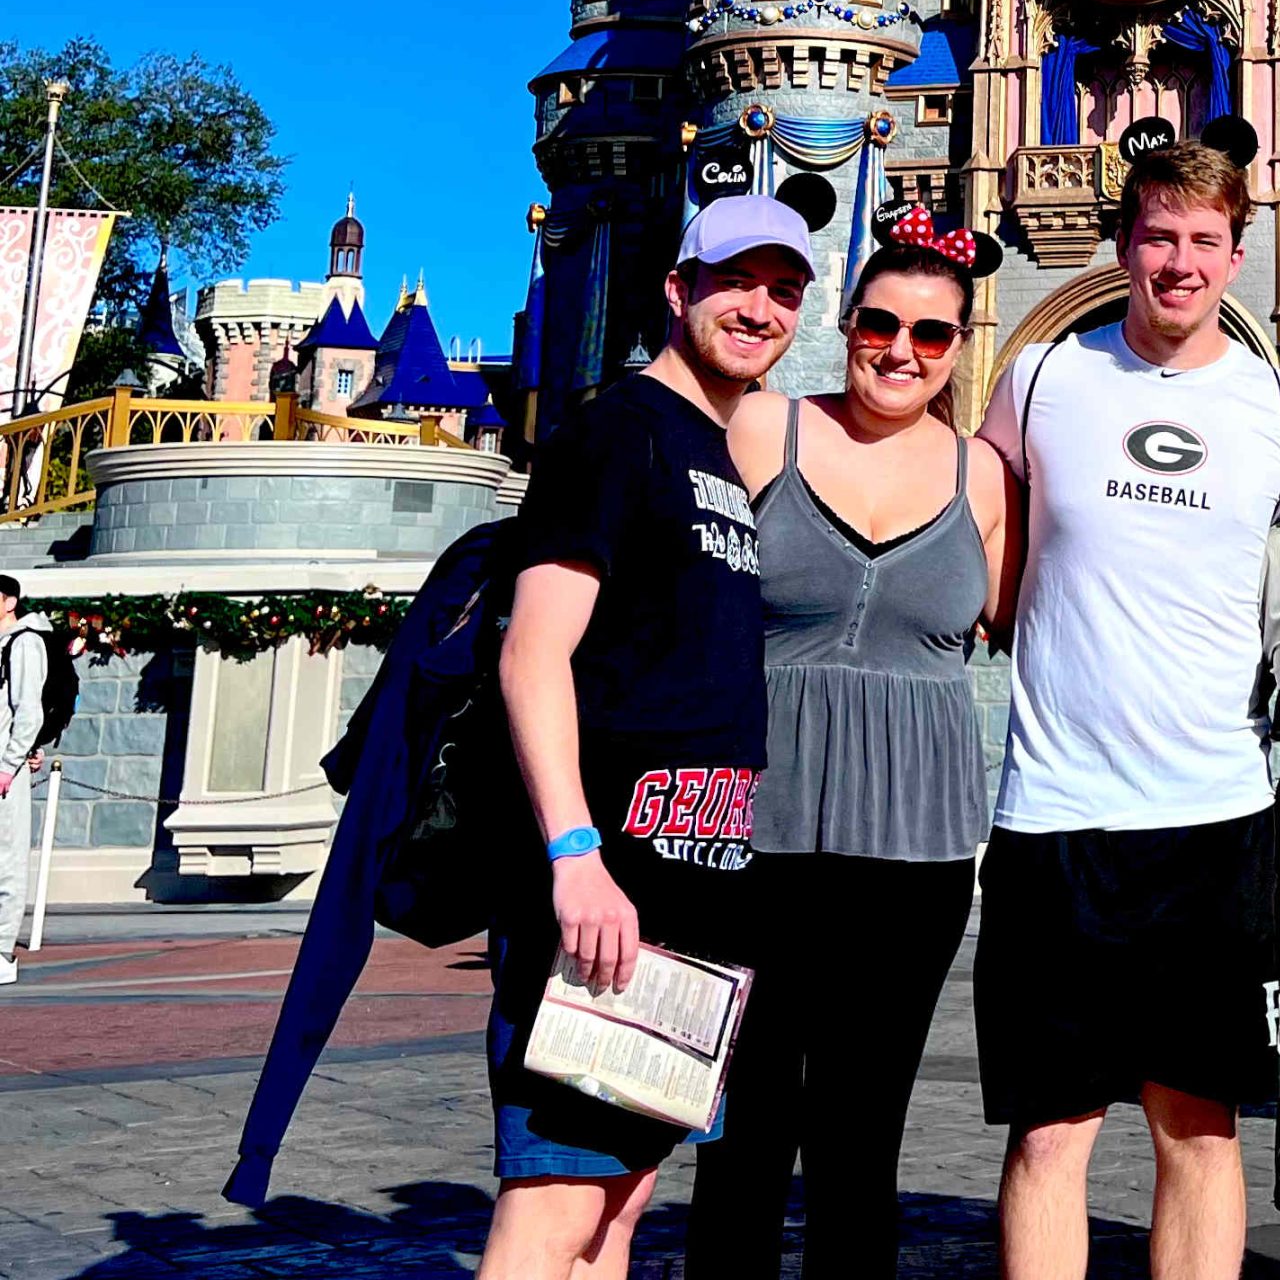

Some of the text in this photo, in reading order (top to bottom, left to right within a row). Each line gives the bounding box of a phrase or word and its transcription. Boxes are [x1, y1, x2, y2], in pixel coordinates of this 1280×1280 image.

[1125, 423, 1205, 474] G
[1106, 479, 1211, 510] BASEBALL
[622, 768, 760, 839] GEOR
